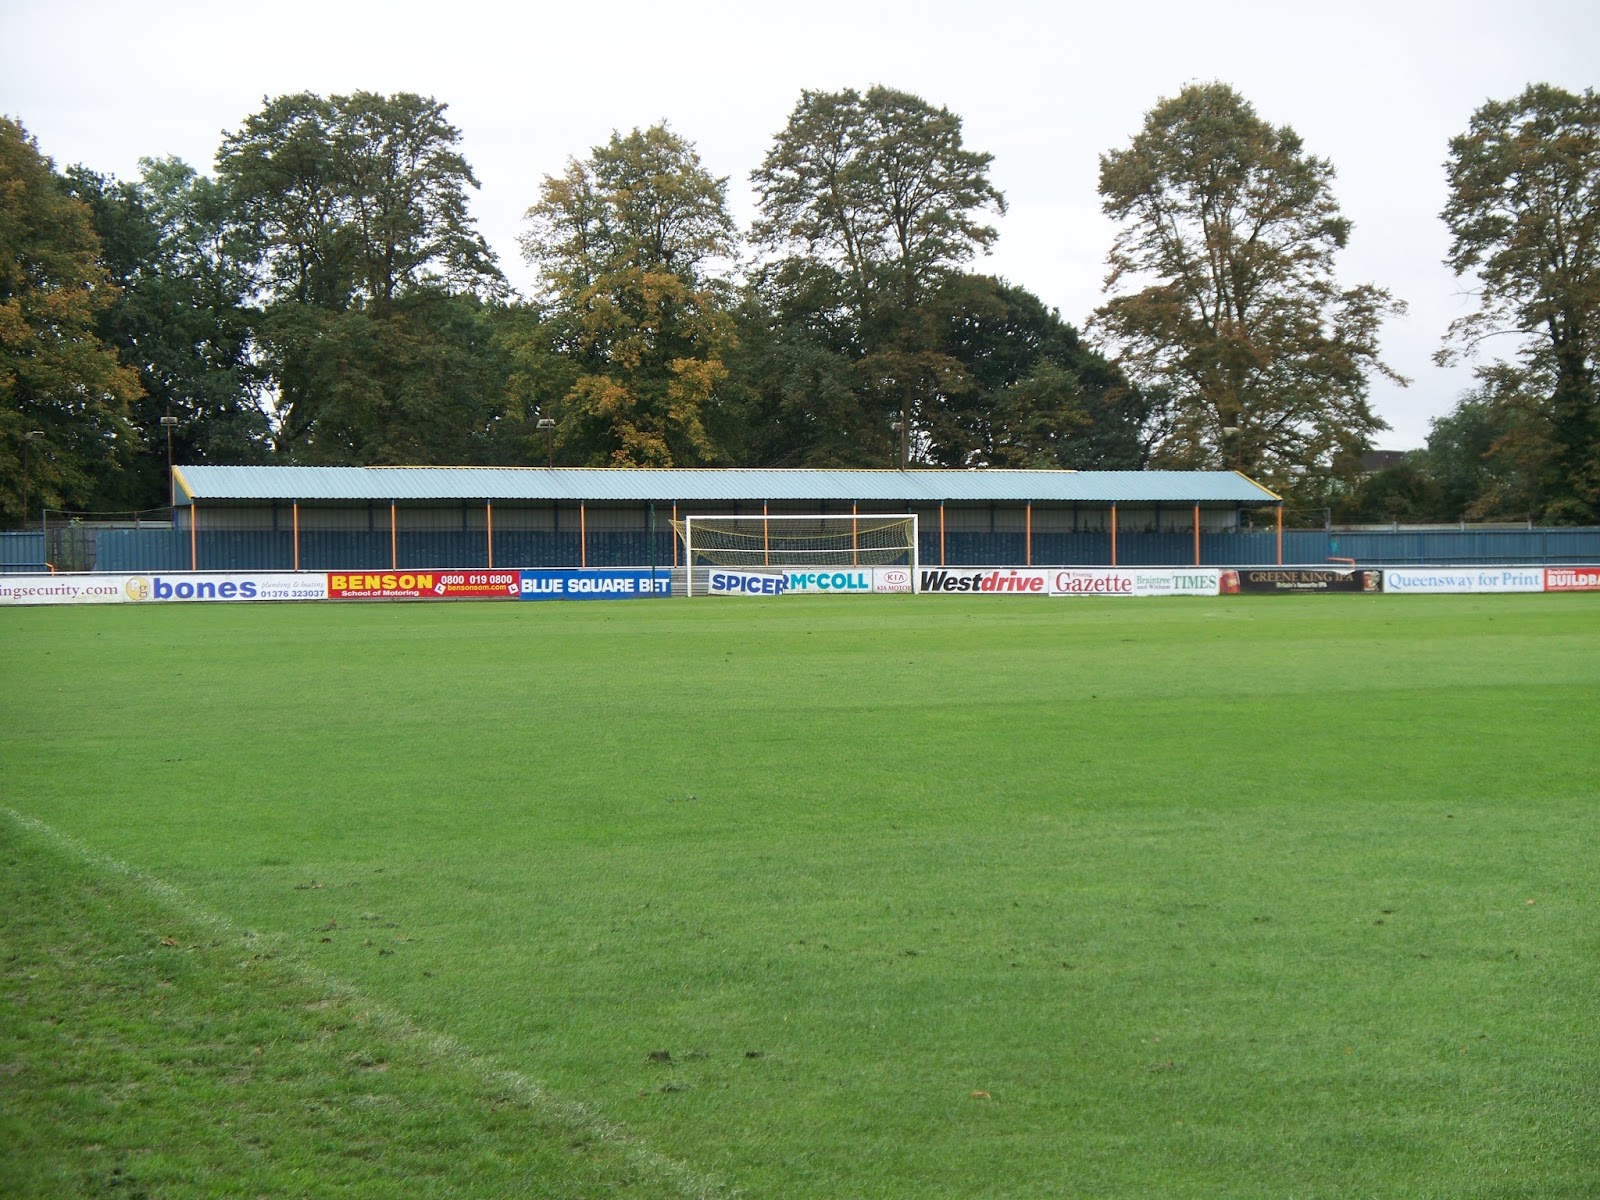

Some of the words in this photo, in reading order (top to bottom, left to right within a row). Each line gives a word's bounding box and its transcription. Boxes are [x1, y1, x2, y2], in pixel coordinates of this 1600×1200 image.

[331, 574, 433, 590] BENSON
[441, 575, 464, 584] 0800
[469, 575, 487, 584] 019
[489, 574, 512, 584] 0800
[711, 574, 789, 595] SPICER
[920, 570, 1044, 592] Westdrive
[1055, 571, 1133, 592] Gazette
[1136, 575, 1171, 585] Braintree
[1172, 574, 1217, 590] TIMES
[1250, 571, 1298, 582] GREENE
[1301, 571, 1333, 582] KING
[1388, 573, 1475, 590] Queensway
[1478, 571, 1499, 586] for
[1502, 572, 1540, 586] Print
[153, 577, 257, 599] bones
[521, 579, 563, 593] BLUE
[567, 579, 634, 592] SQUARE
[639, 578, 670, 592] BET
[261, 590, 289, 598] 01376
[292, 590, 325, 598] 323037
